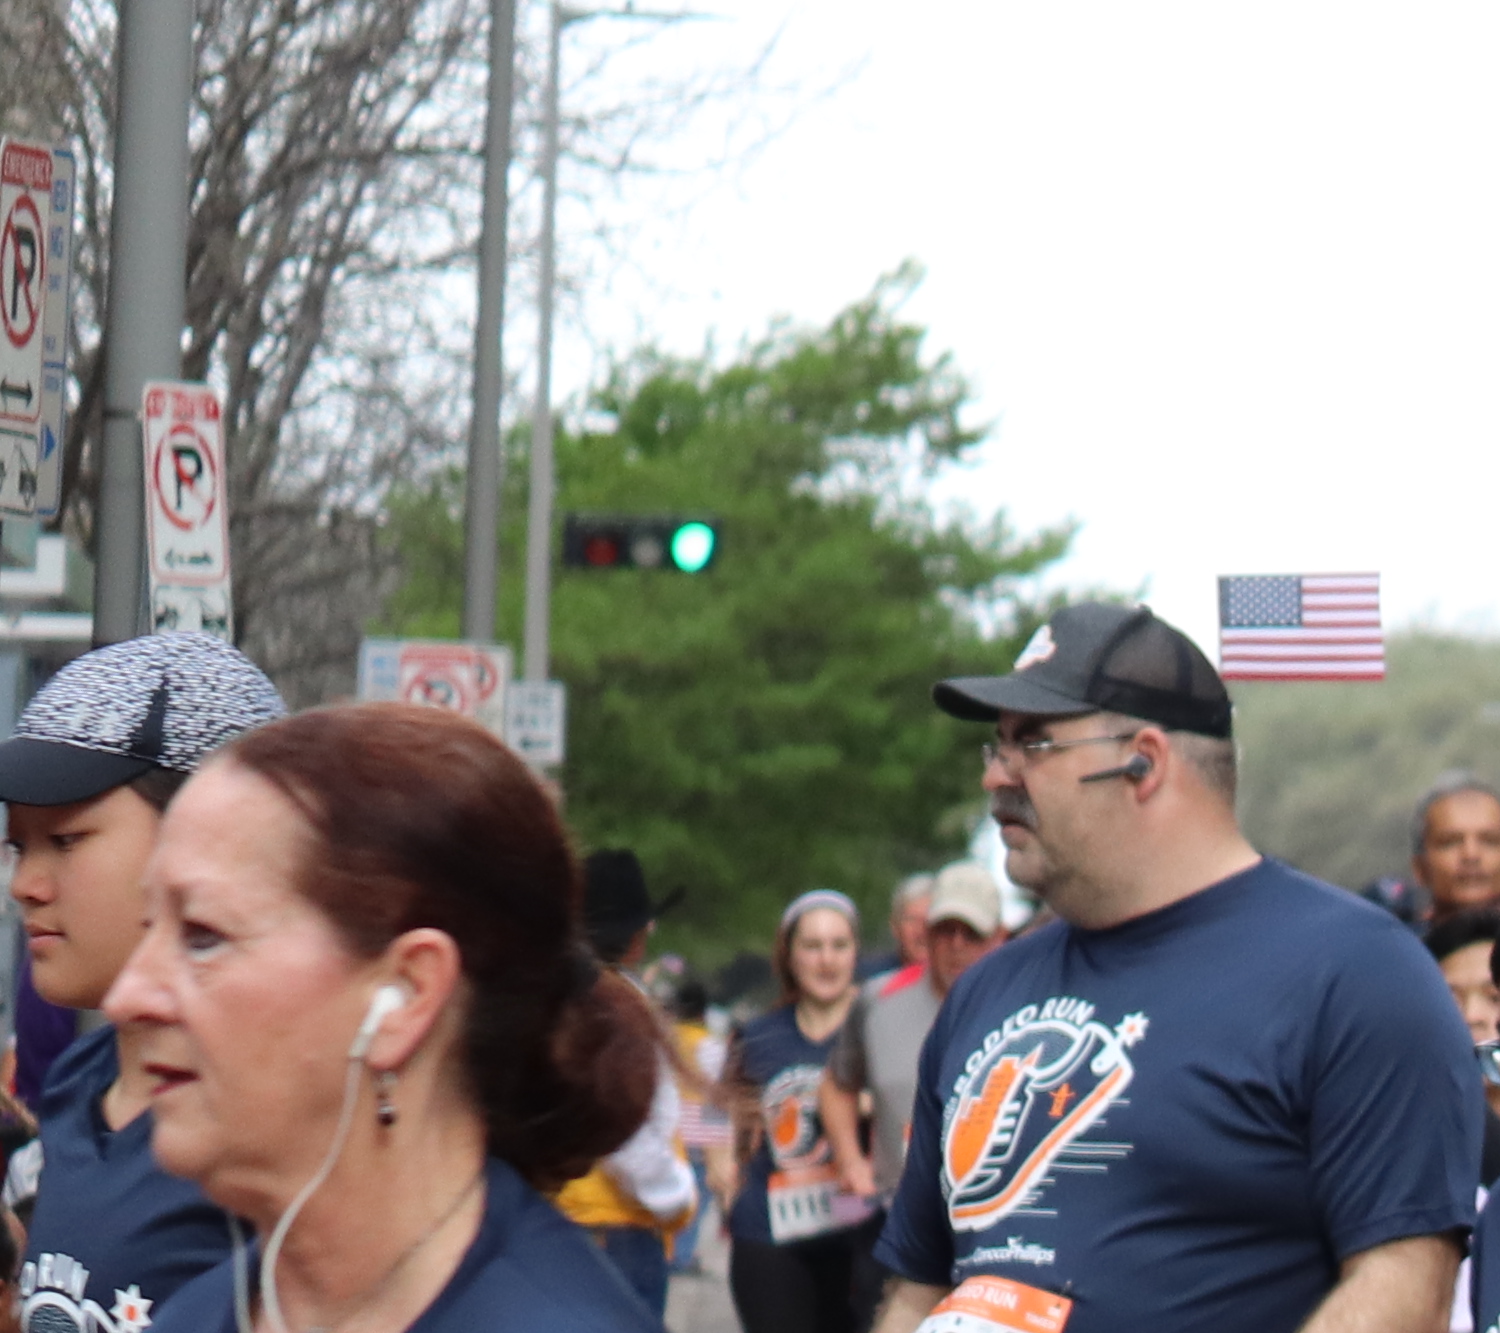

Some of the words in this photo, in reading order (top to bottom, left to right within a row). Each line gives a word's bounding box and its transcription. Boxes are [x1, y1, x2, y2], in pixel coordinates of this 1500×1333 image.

[953, 1003, 1039, 1095] RODEO
[1039, 996, 1095, 1026] RUN
[985, 1286, 1019, 1310] RUN
